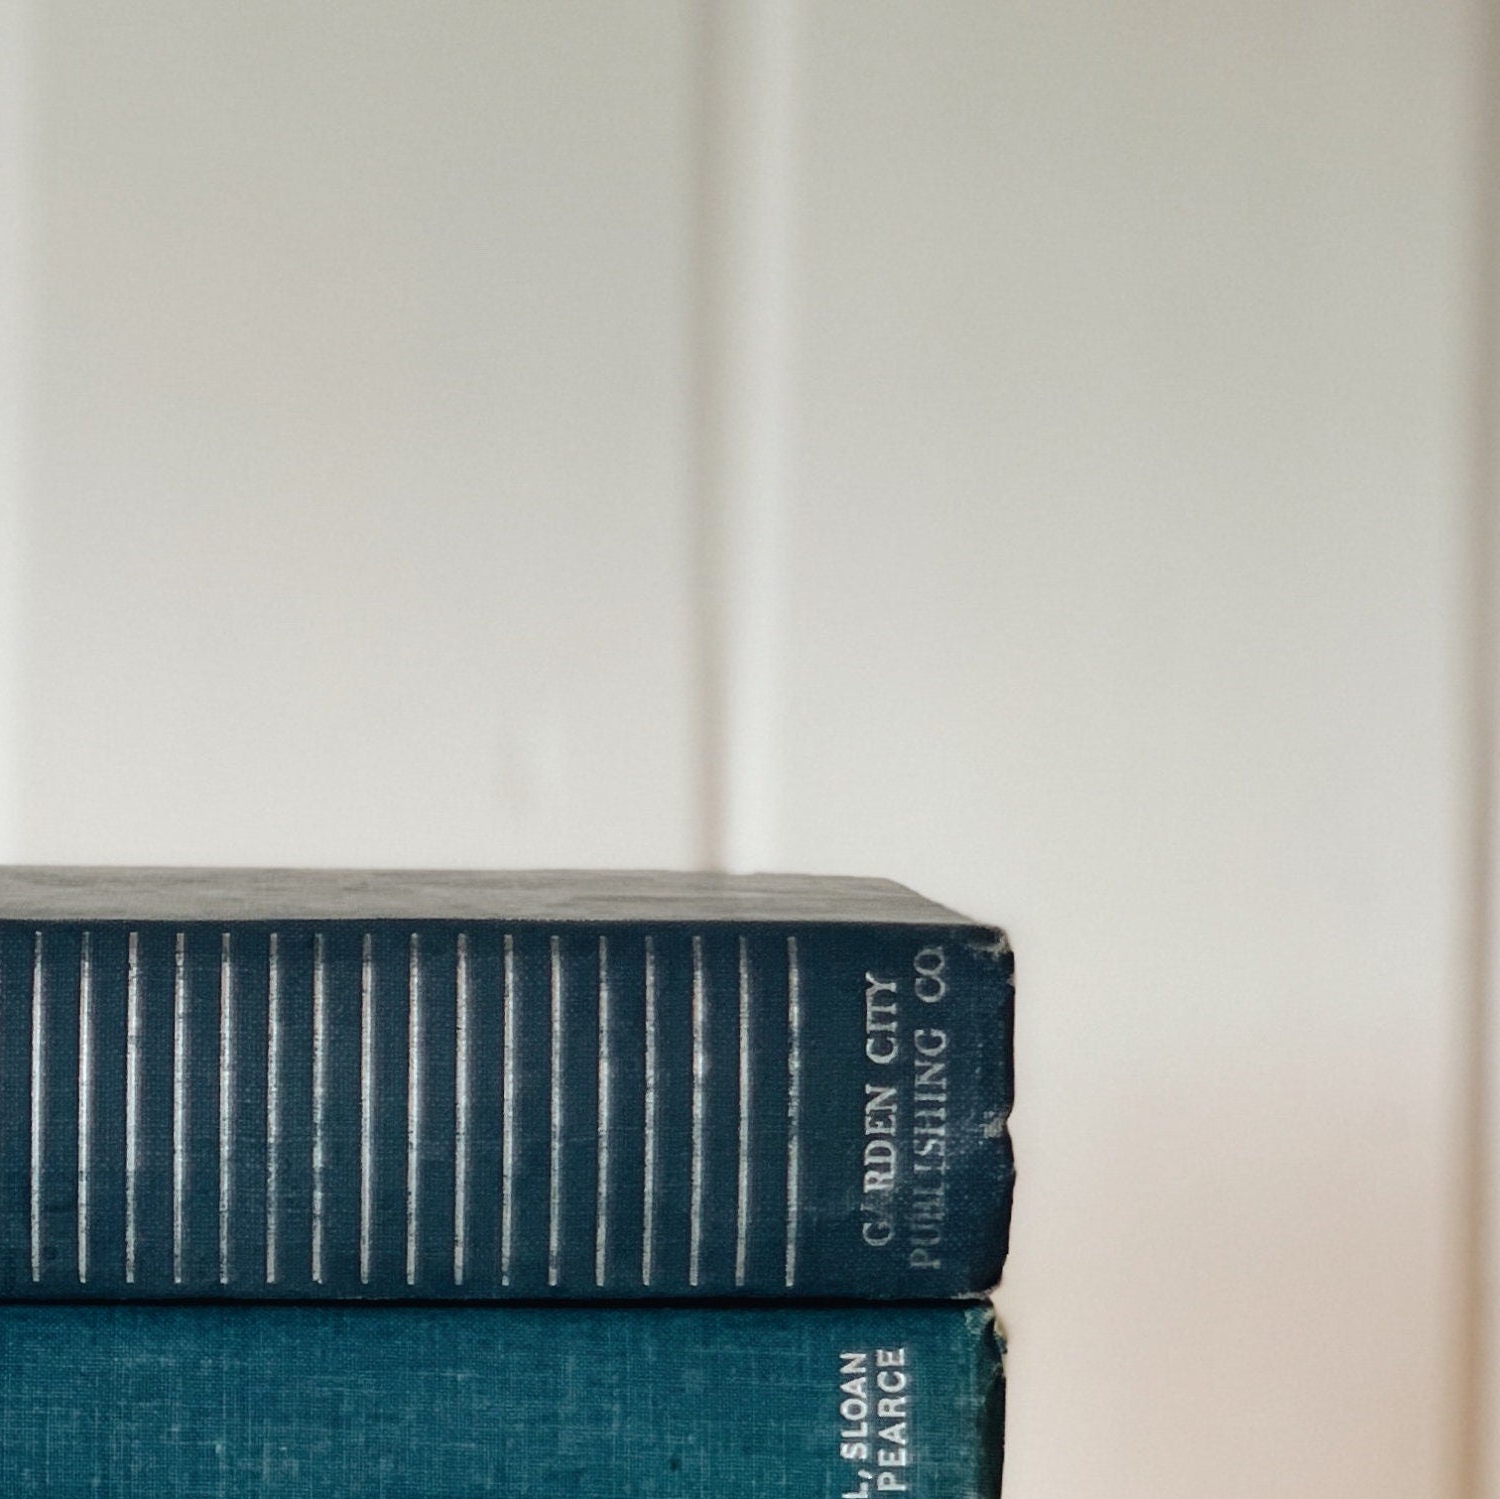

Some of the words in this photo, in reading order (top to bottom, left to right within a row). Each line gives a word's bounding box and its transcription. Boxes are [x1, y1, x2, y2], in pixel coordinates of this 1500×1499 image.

[865, 971, 898, 1064] CITY
[910, 1029, 947, 1269] PUBLISHING
[840, 1352, 868, 1460] SLOAN
[877, 1349, 906, 1491] PEARCE
